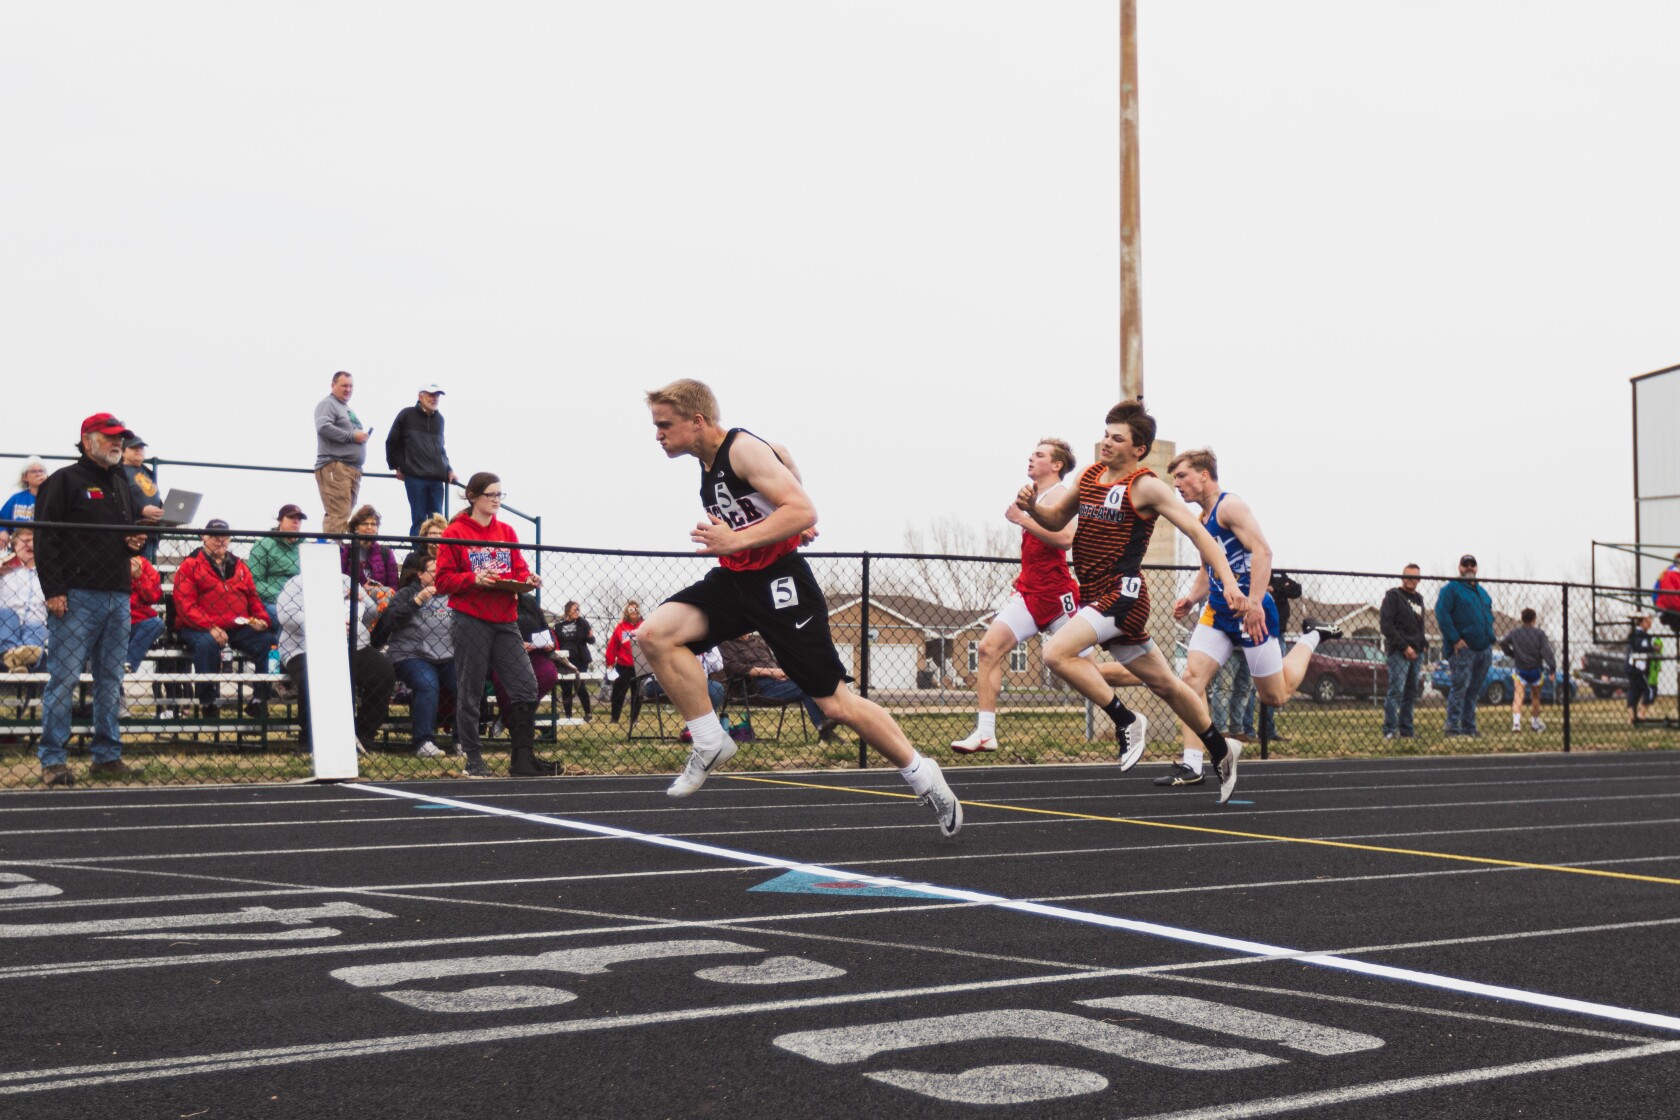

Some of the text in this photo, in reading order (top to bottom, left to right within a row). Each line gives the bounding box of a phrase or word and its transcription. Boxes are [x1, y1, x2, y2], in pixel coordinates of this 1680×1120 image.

[717, 484, 732, 508] 5
[776, 578, 793, 603] 5
[1063, 595, 1074, 612] 8
